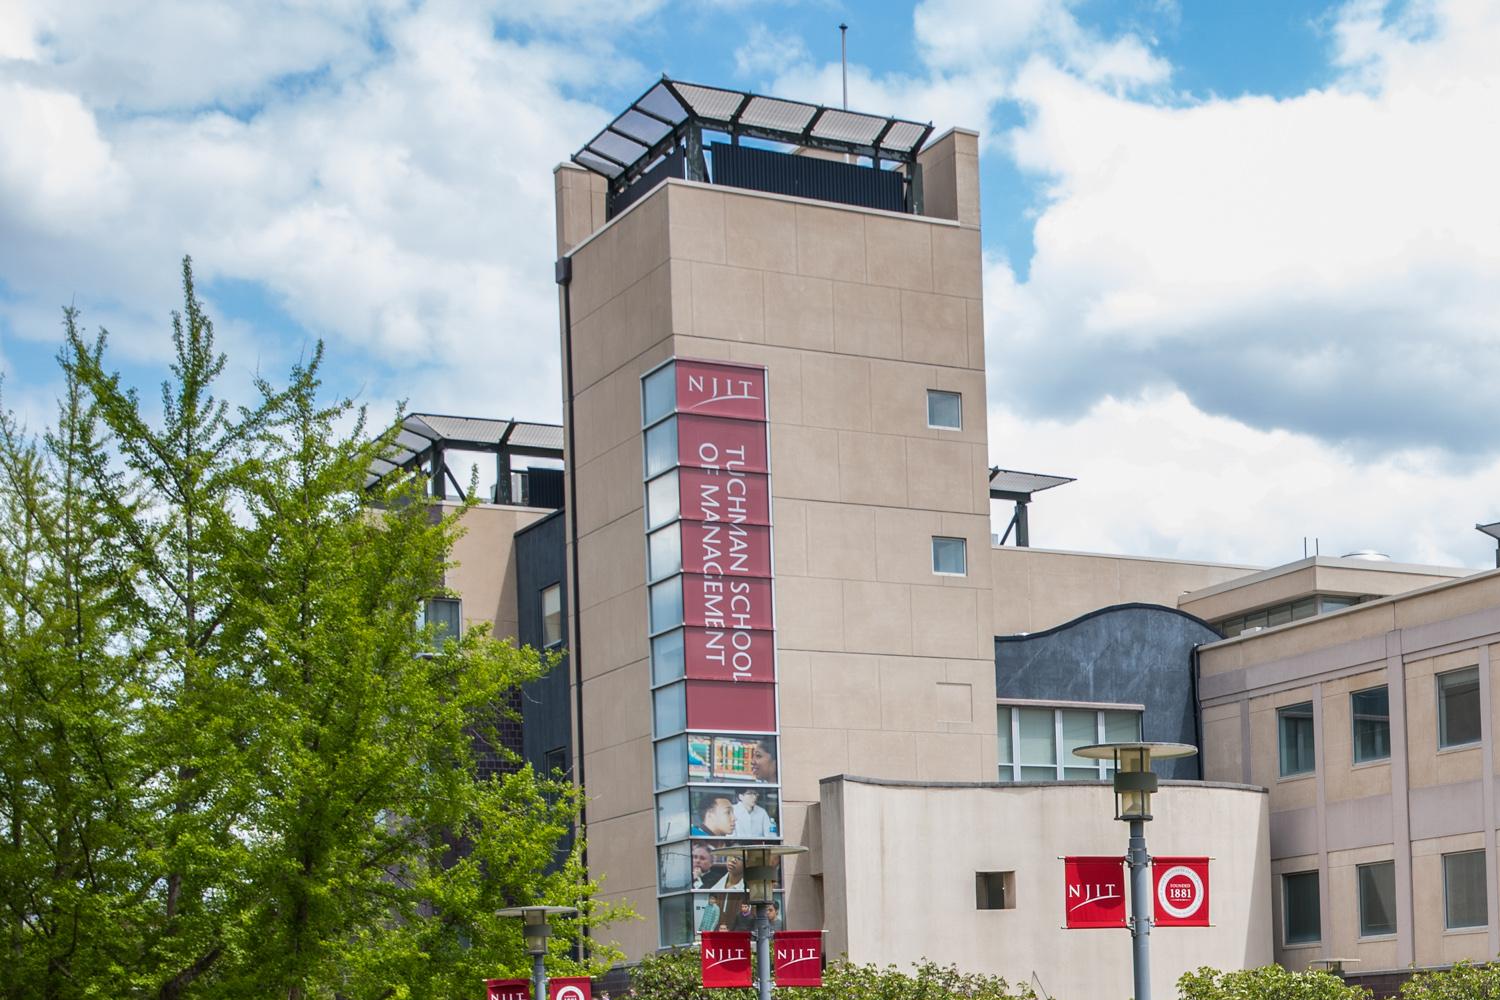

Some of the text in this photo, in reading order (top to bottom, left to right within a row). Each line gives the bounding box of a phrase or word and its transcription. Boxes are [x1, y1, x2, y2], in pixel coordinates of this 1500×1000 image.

[688, 375, 753, 398] NJIT
[699, 442, 725, 667] OF MANAGEMENT
[726, 445, 752, 683] TUCHMAN SCHOOL
[1069, 884, 1116, 900] NJIT
[1170, 889, 1192, 898] 1881
[706, 949, 744, 960] NJIT
[777, 948, 816, 960] NJIT
